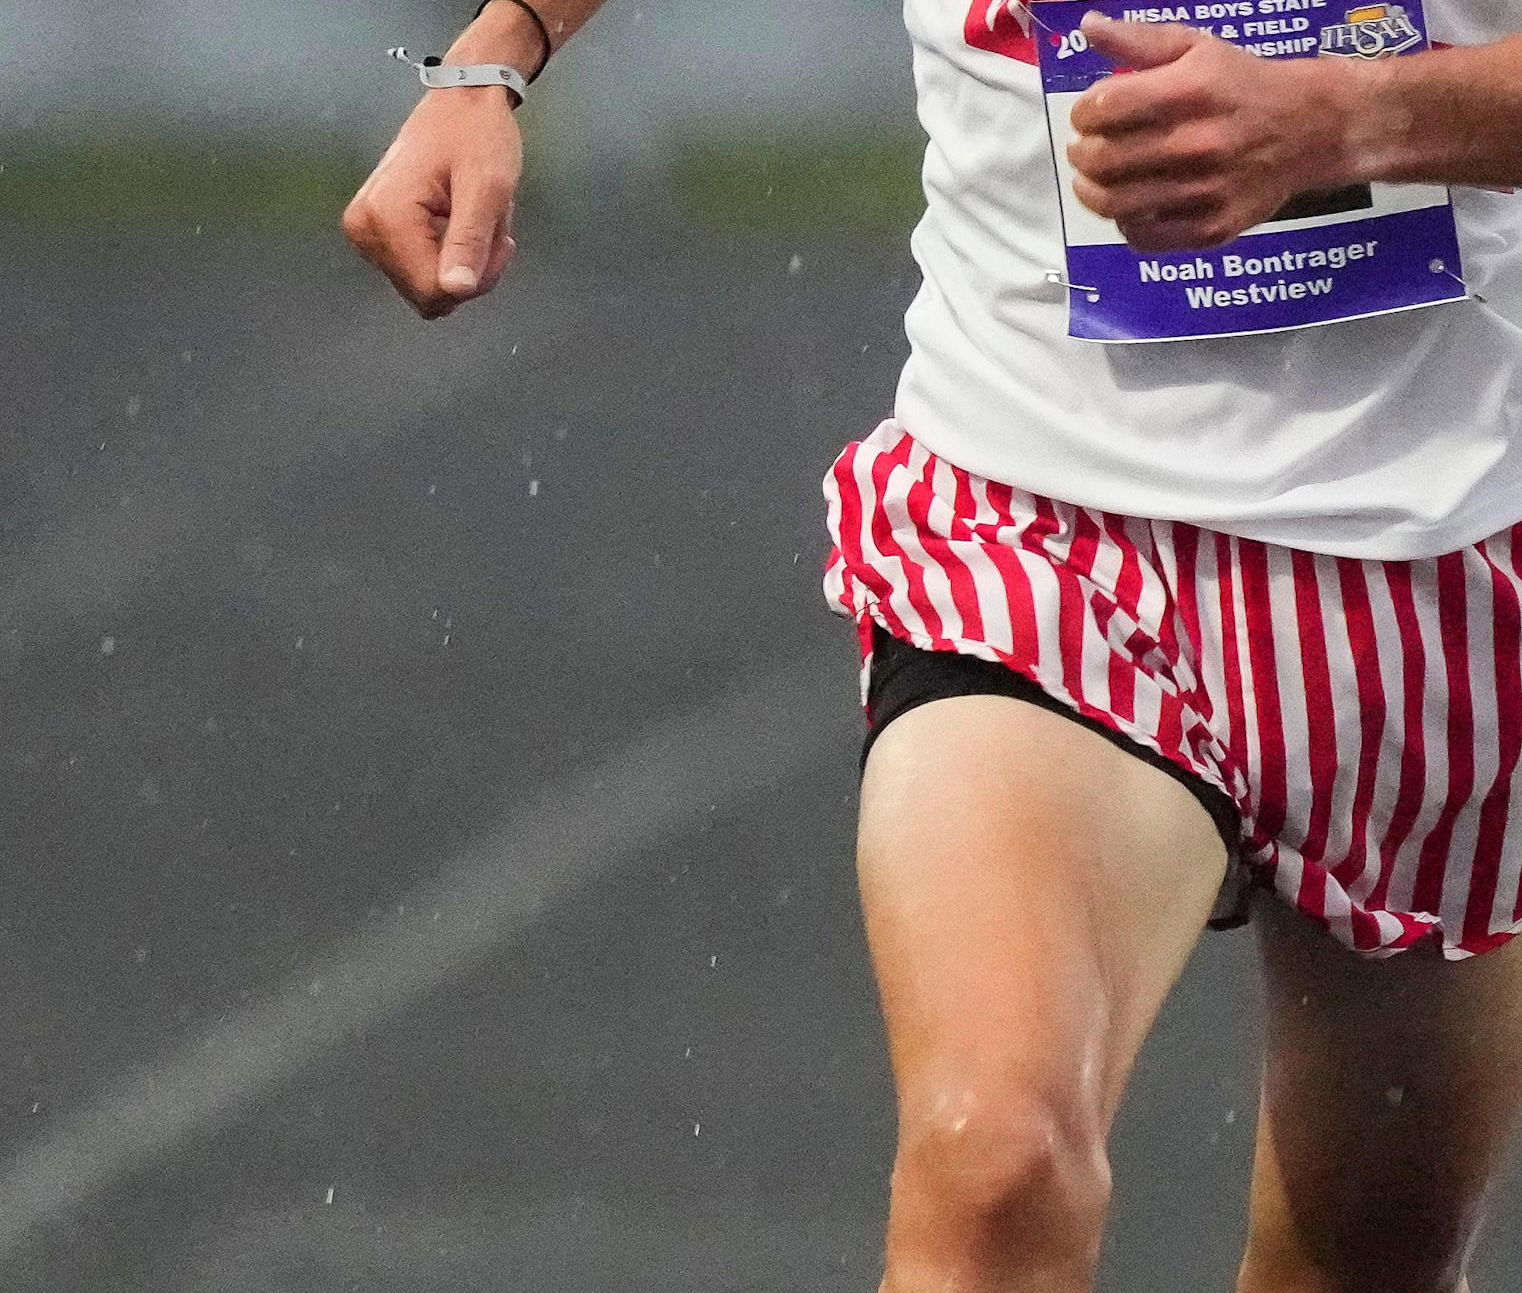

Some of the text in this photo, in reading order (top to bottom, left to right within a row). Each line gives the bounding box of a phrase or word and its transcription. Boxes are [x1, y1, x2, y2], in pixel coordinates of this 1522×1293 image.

[1123, 7, 1191, 24] IHSAA
[1194, 1, 1254, 20] BOYS
[1220, 24, 1240, 39] &
[1243, 17, 1310, 38] FIELD
[1320, 16, 1417, 59] IHSAA
[1138, 240, 1378, 283] Noah Bontrager
[1185, 277, 1333, 309] Westview
